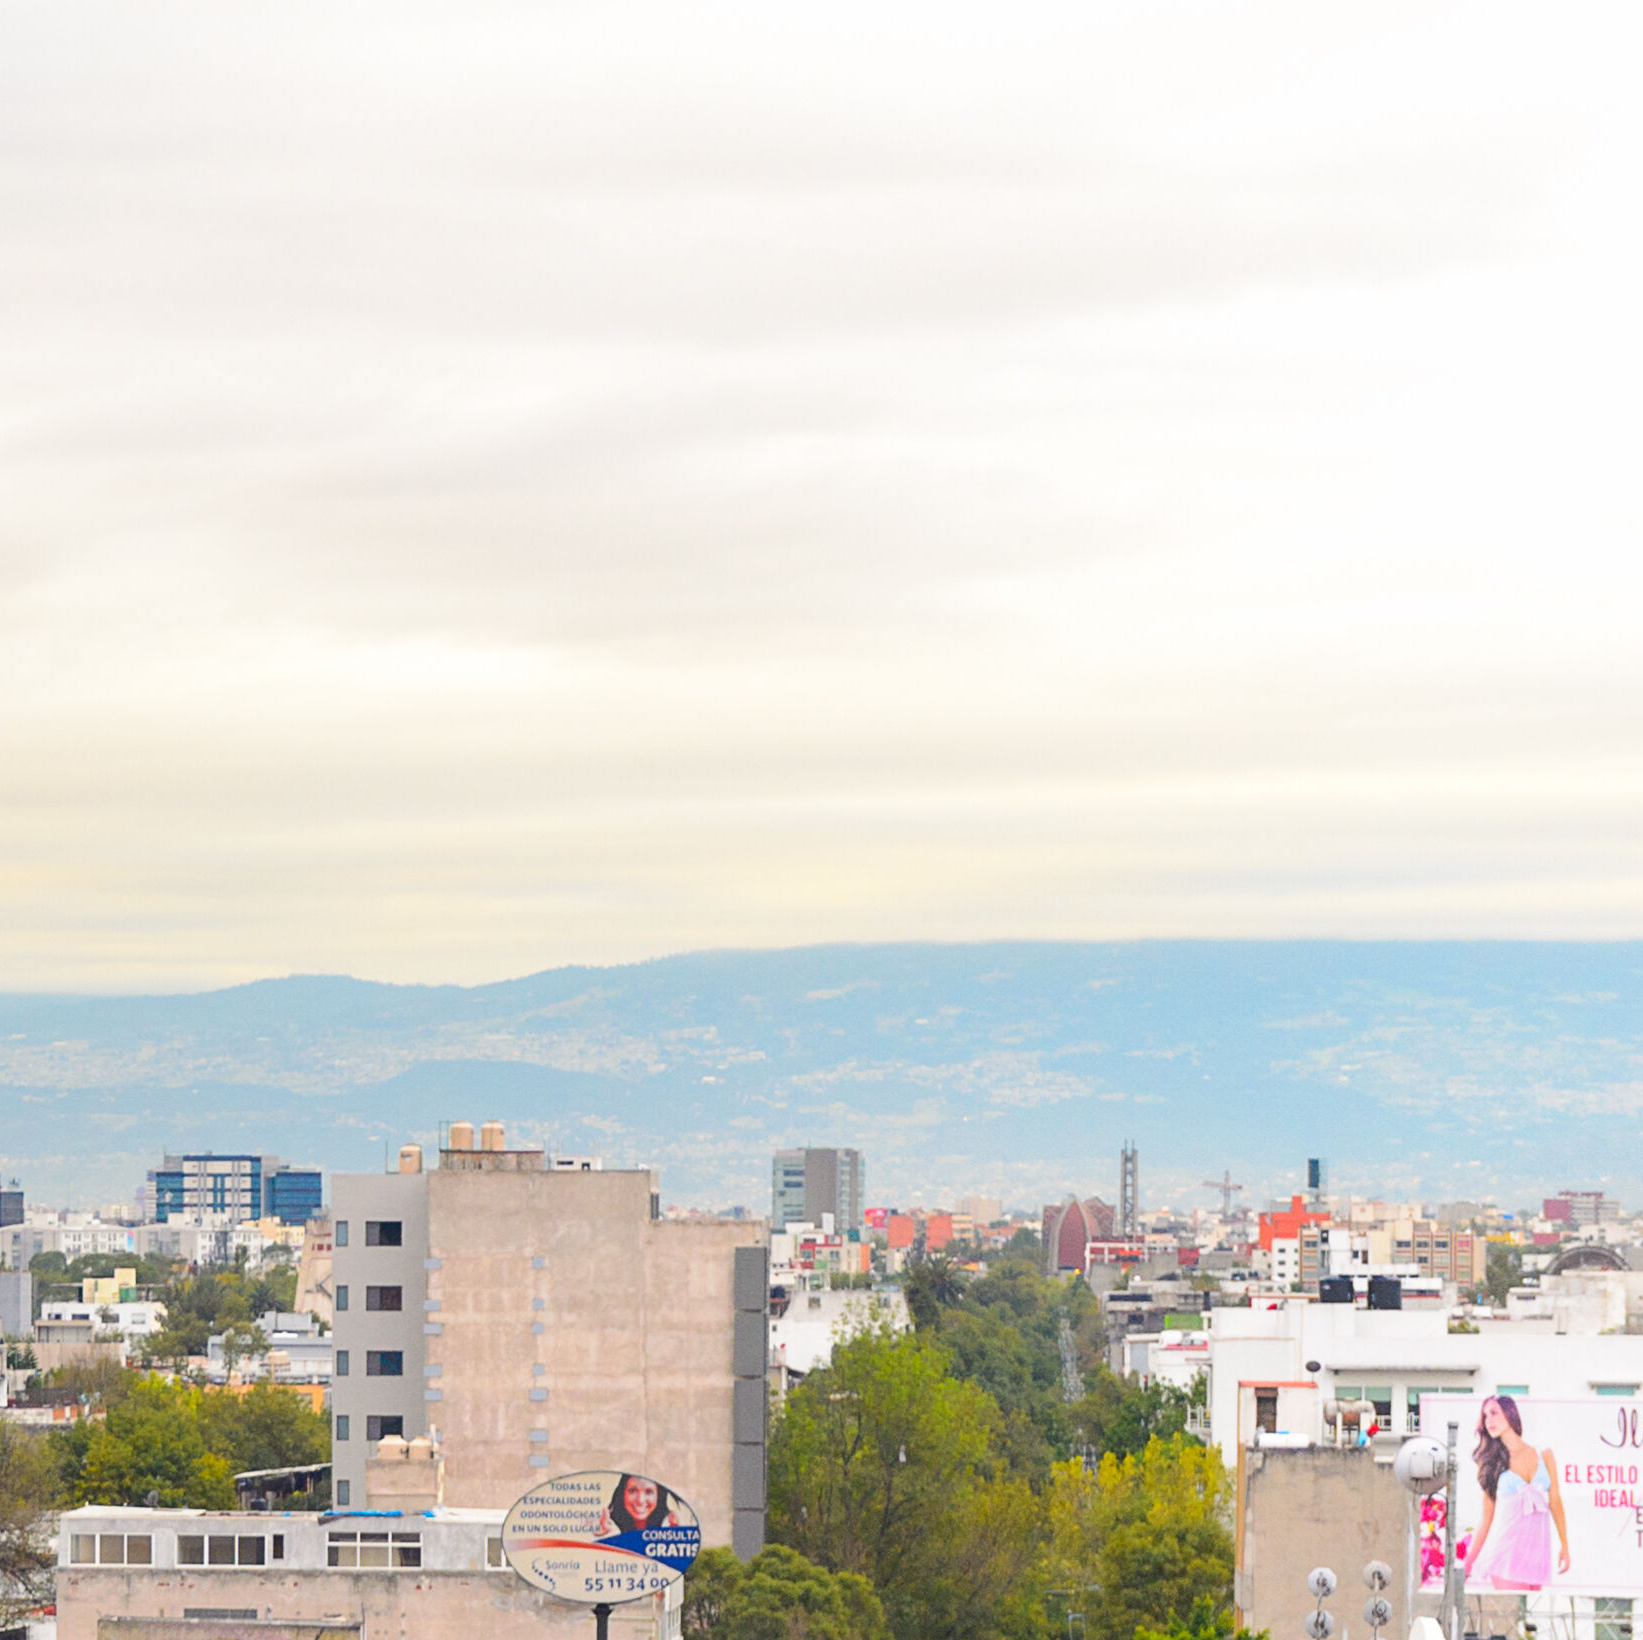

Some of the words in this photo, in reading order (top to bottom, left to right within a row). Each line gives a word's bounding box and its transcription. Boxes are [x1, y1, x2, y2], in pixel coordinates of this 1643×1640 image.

[1565, 1464, 1582, 1483] EL
[1587, 1464, 1638, 1484] ESTILO
[551, 1483, 581, 1491] TODAS
[584, 1483, 601, 1491] LAS
[523, 1496, 601, 1505] ESPECIALIDADES
[1595, 1489, 1637, 1508] IDEAL
[512, 1525, 525, 1533] EN
[527, 1525, 541, 1533] UN
[543, 1525, 568, 1533] SOLO
[570, 1525, 601, 1533] LUGAR
[642, 1529, 700, 1541] CONSULTA
[645, 1543, 699, 1557] GRATIS
[595, 1560, 638, 1574] Llame
[643, 1563, 658, 1575] ya
[585, 1578, 604, 1591] 55
[609, 1578, 621, 1588] 11
[627, 1578, 645, 1591] 34
